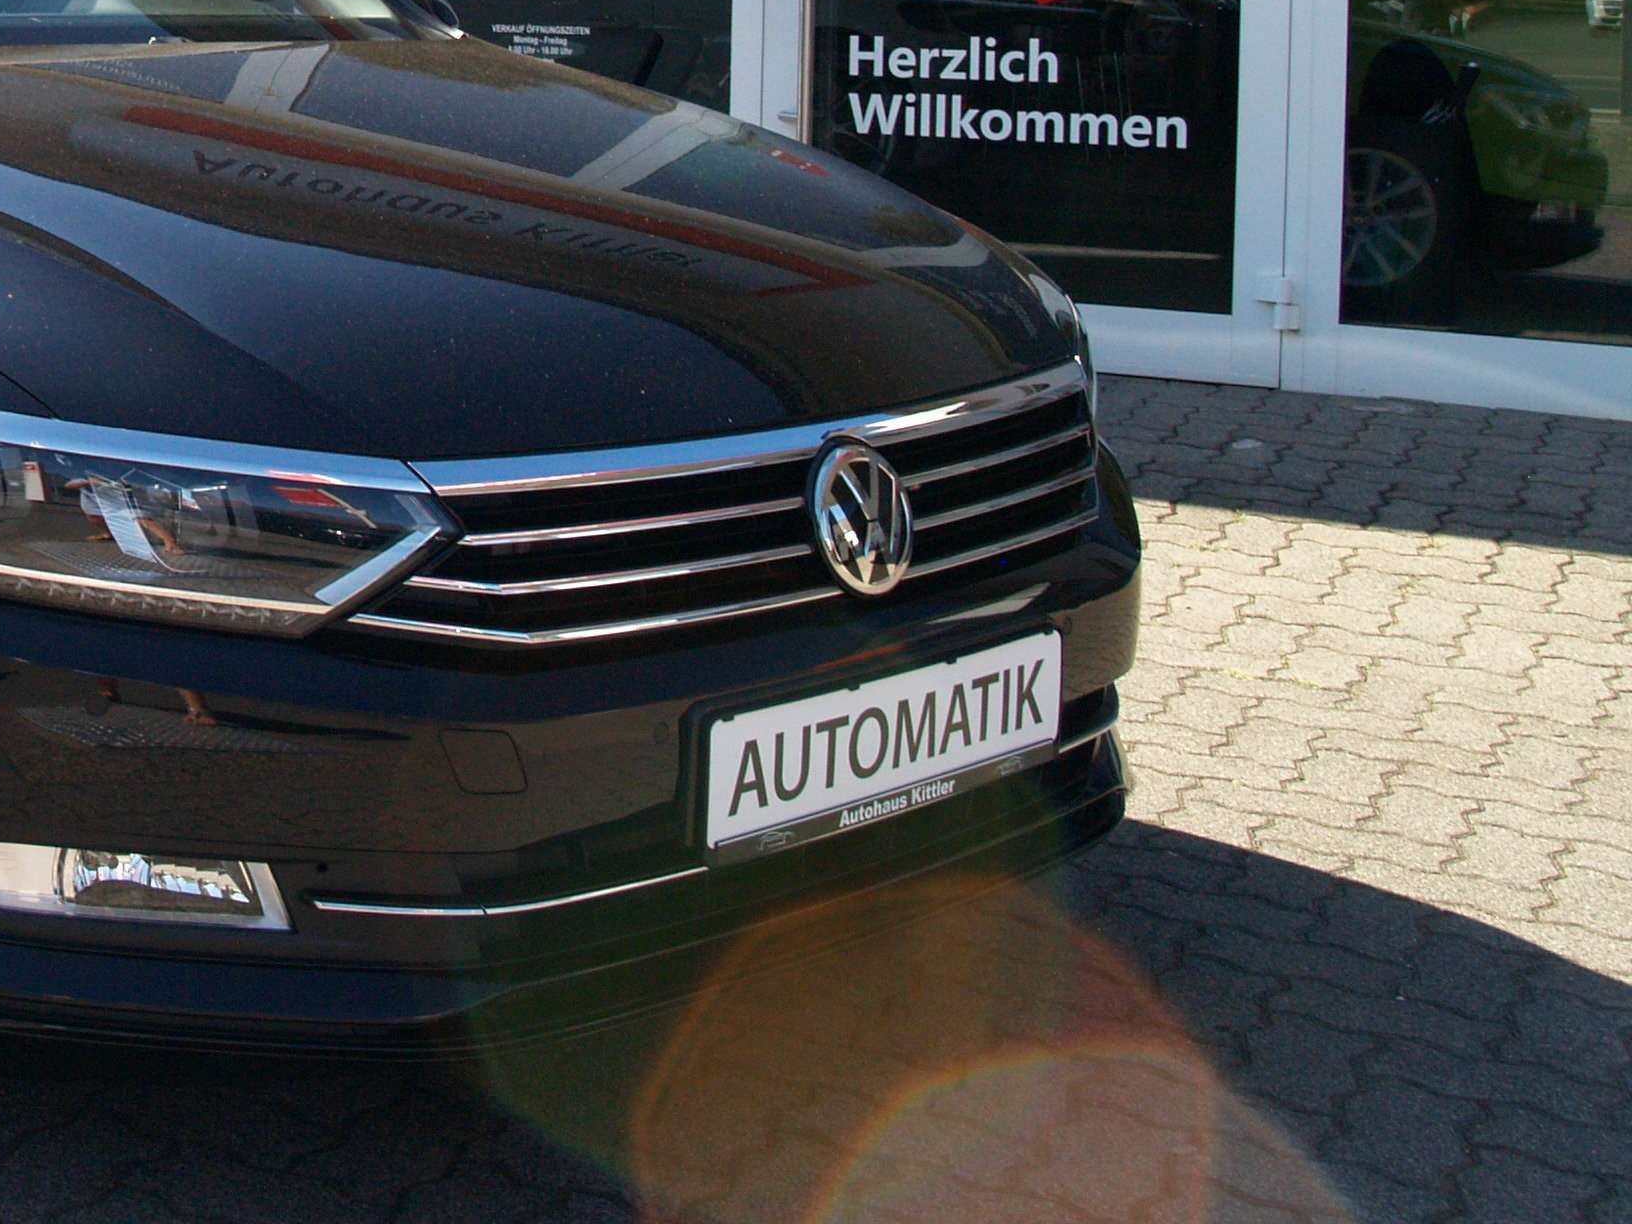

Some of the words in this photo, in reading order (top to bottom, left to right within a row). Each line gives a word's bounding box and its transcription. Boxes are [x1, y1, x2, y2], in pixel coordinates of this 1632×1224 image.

[491, 23, 525, 33] VERKAUF
[526, 22, 591, 36] ÖFFNUNGSZEITEN
[848, 35, 1059, 84] Herzlich
[848, 93, 1188, 149] Willkommen
[728, 658, 1045, 818] AUTOMATIK
[839, 796, 908, 828] Autohaus
[911, 778, 956, 807] Kittler
